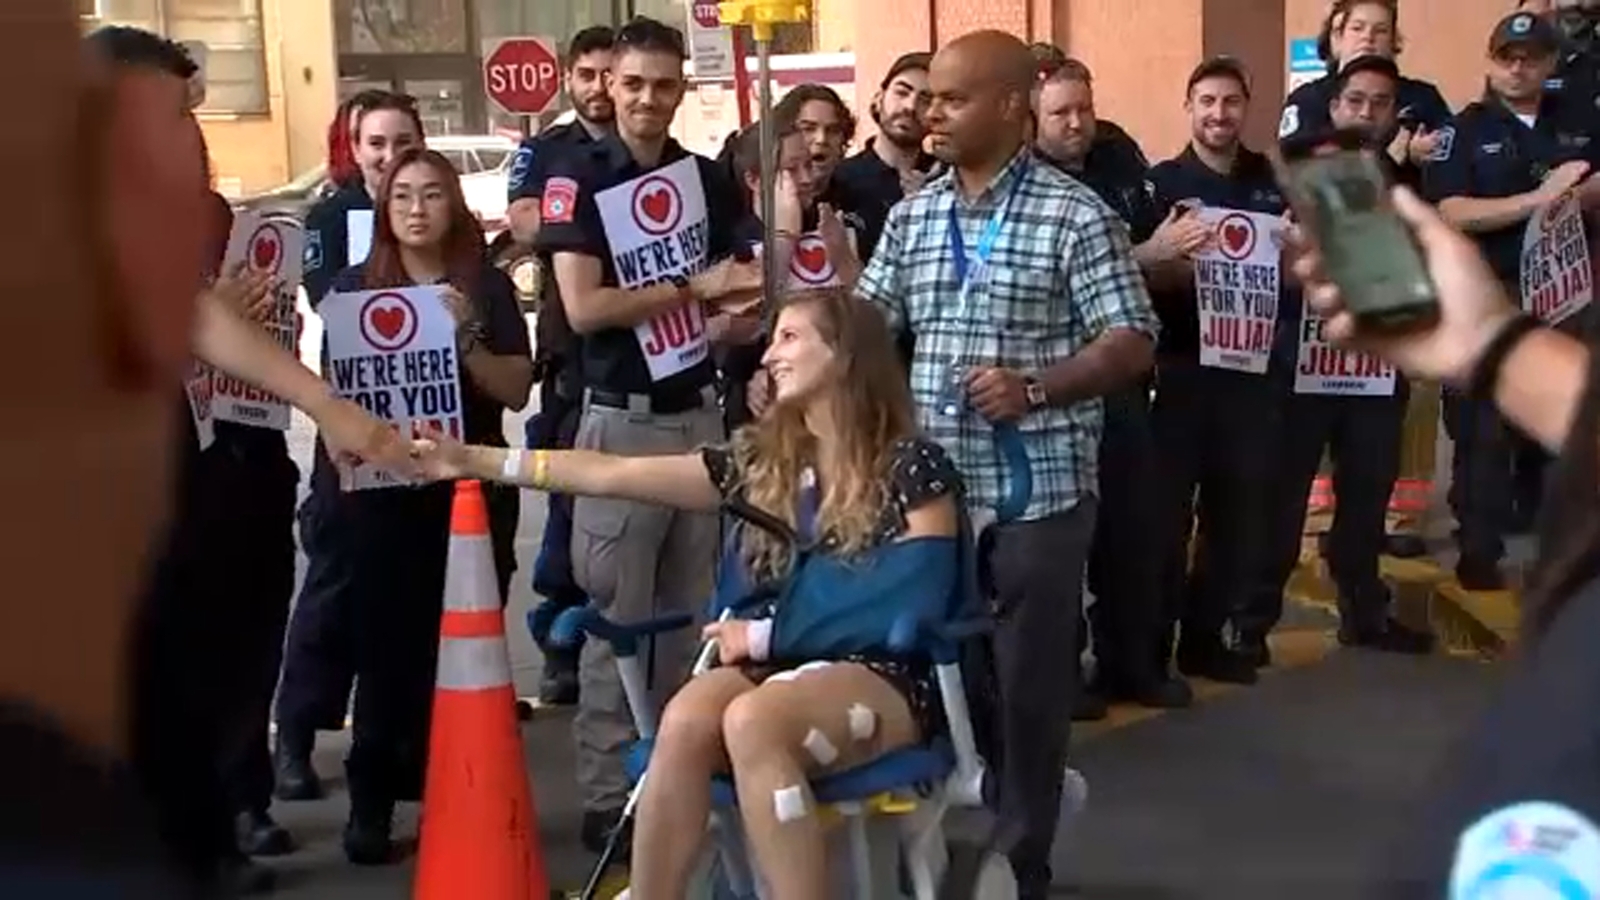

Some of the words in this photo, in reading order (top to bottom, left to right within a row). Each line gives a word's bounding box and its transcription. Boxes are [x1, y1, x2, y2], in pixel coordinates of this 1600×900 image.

[490, 62, 554, 93] STOP
[616, 234, 679, 284] WE'RE
[1196, 258, 1240, 289] WE'RE
[1242, 263, 1276, 294] HERE
[1521, 259, 1554, 298] FOR
[1200, 286, 1236, 315] FOR
[1241, 290, 1276, 320] YOU
[1203, 314, 1272, 355] JULIA!
[332, 354, 399, 391] WE'RE
[404, 347, 455, 384] HERE
[339, 390, 393, 420] OR
[401, 383, 457, 417] YOU
